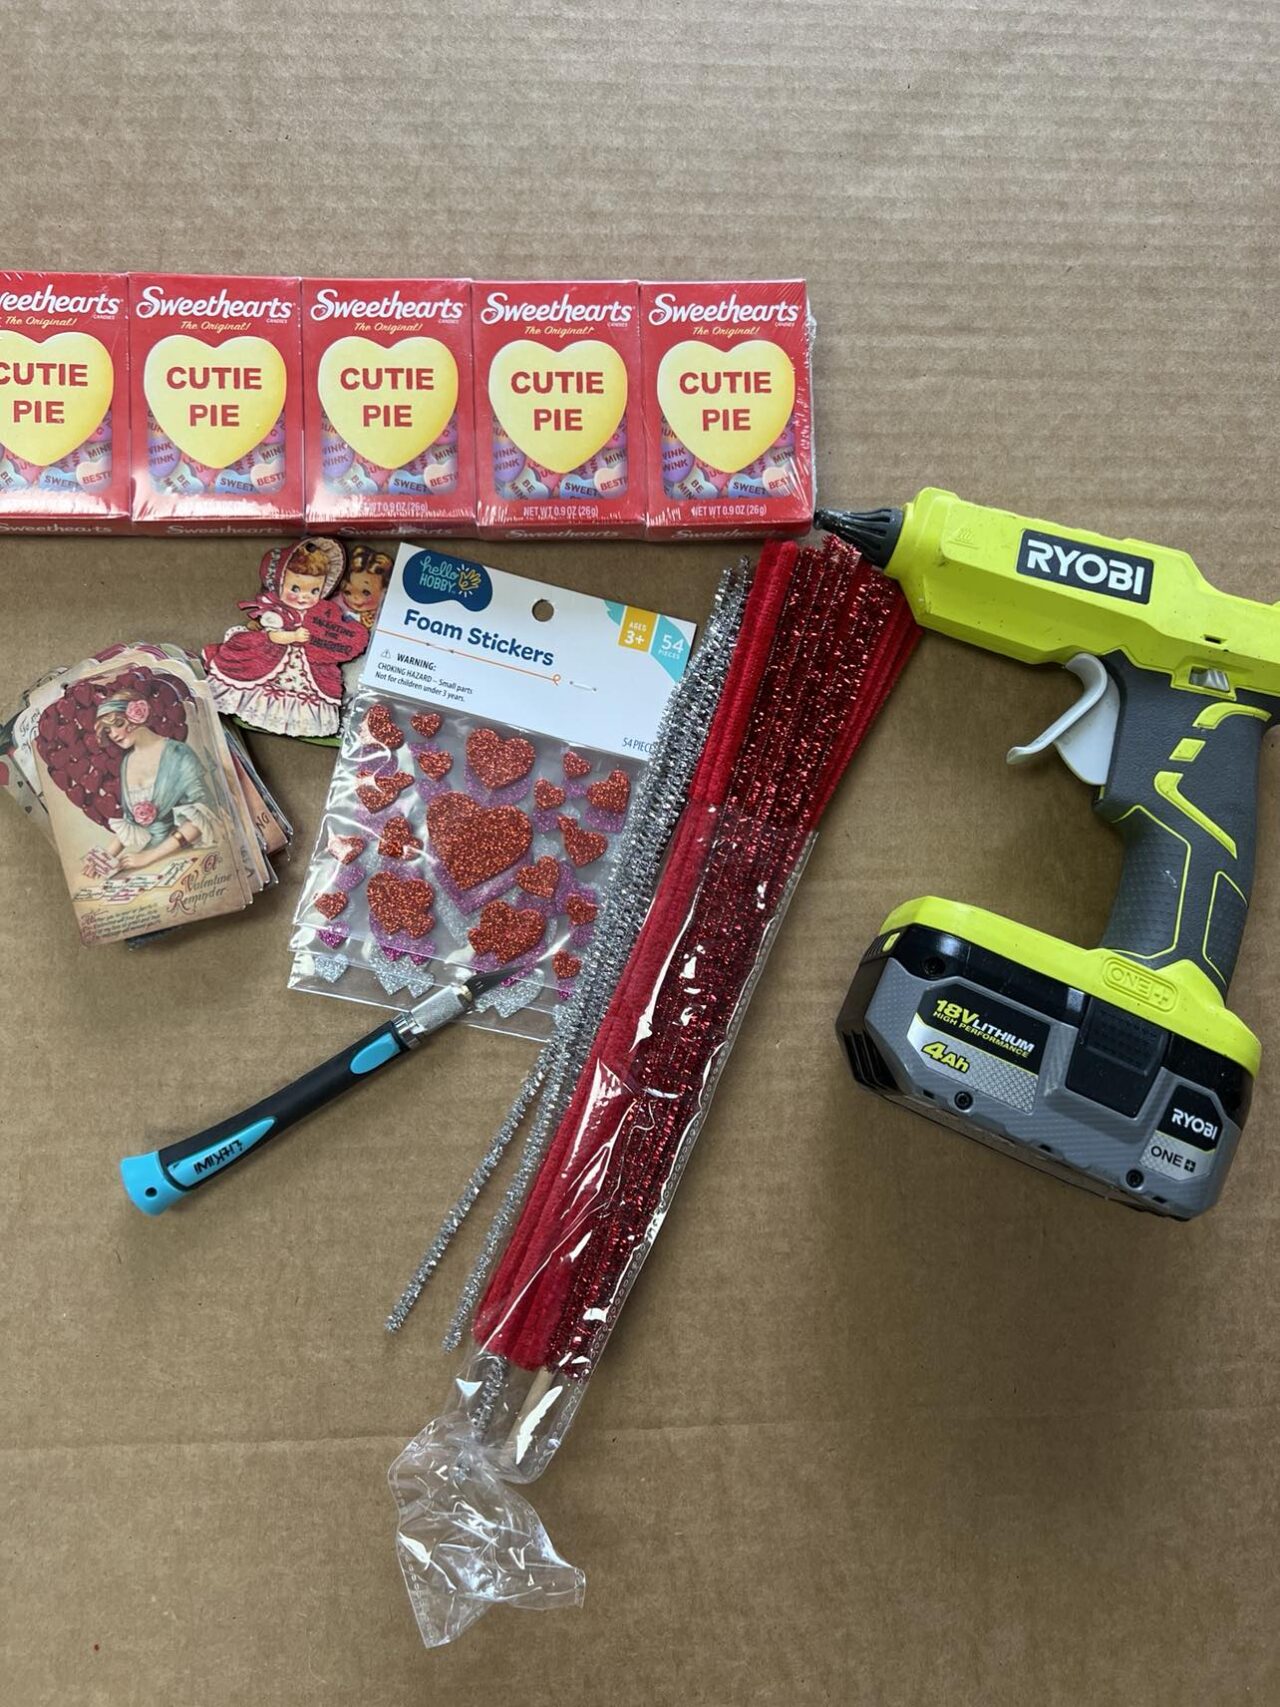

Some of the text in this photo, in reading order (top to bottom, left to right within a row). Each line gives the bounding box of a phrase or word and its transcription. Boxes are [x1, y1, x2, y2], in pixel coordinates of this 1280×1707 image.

[136, 286, 293, 319] Sweethearts
[310, 288, 464, 321] Sweethearts
[480, 292, 632, 324] Sweethearts
[648, 293, 799, 325] Sweethearts
[5, 316, 78, 329] The Original!
[180, 321, 251, 334] The Original!
[354, 323, 423, 335] The Original!
[524, 326, 594, 338] The Original!
[692, 326, 760, 338] The Original!
[166, 367, 262, 390] CUTIE
[340, 367, 434, 391] CUTIE
[510, 371, 604, 394] CUTIE
[679, 371, 772, 394] CUTIE
[13, 400, 65, 424] PIE
[189, 404, 240, 427] PIE
[362, 405, 413, 428] PIE
[533, 408, 583, 431] PIE
[702, 408, 752, 431] PIE
[394, 478, 428, 492] SWEET
[522, 479, 536, 493] BE
[564, 482, 598, 497] SWEET
[691, 479, 705, 494] BE
[733, 481, 767, 495] SWEET
[523, 505, 599, 518] NET WT 0.9 OZ (26g)
[691, 504, 767, 516] NET WT 0.9 OZ (26g)
[166, 525, 283, 535] Sweethearts
[419, 556, 460, 580] hello
[1027, 539, 1145, 595] RYOBI
[419, 573, 456, 593] HOBBY
[404, 608, 554, 666] Foam Stickers
[624, 630, 645, 645] 3+
[661, 634, 684, 653] 54
[397, 653, 437, 671] WARNING:
[658, 650, 680, 660] PIECES
[375, 671, 387, 680] Not
[388, 674, 397, 683] for
[397, 677, 423, 689] children
[423, 686, 442, 696] under
[378, 662, 406, 676] CHOKING
[406, 670, 433, 683] HAZARD
[438, 679, 457, 689] Small
[456, 685, 473, 695] parts
[622, 737, 633, 749] 54
[181, 869, 233, 893] Valentine
[167, 886, 228, 917] Reminder
[932, 1011, 1029, 1058] HIGH PERFORMANCE
[937, 1000, 1035, 1053] 18V LITHIUM
[922, 1041, 970, 1073] 4Ah
[1171, 1108, 1218, 1140] RYOBI
